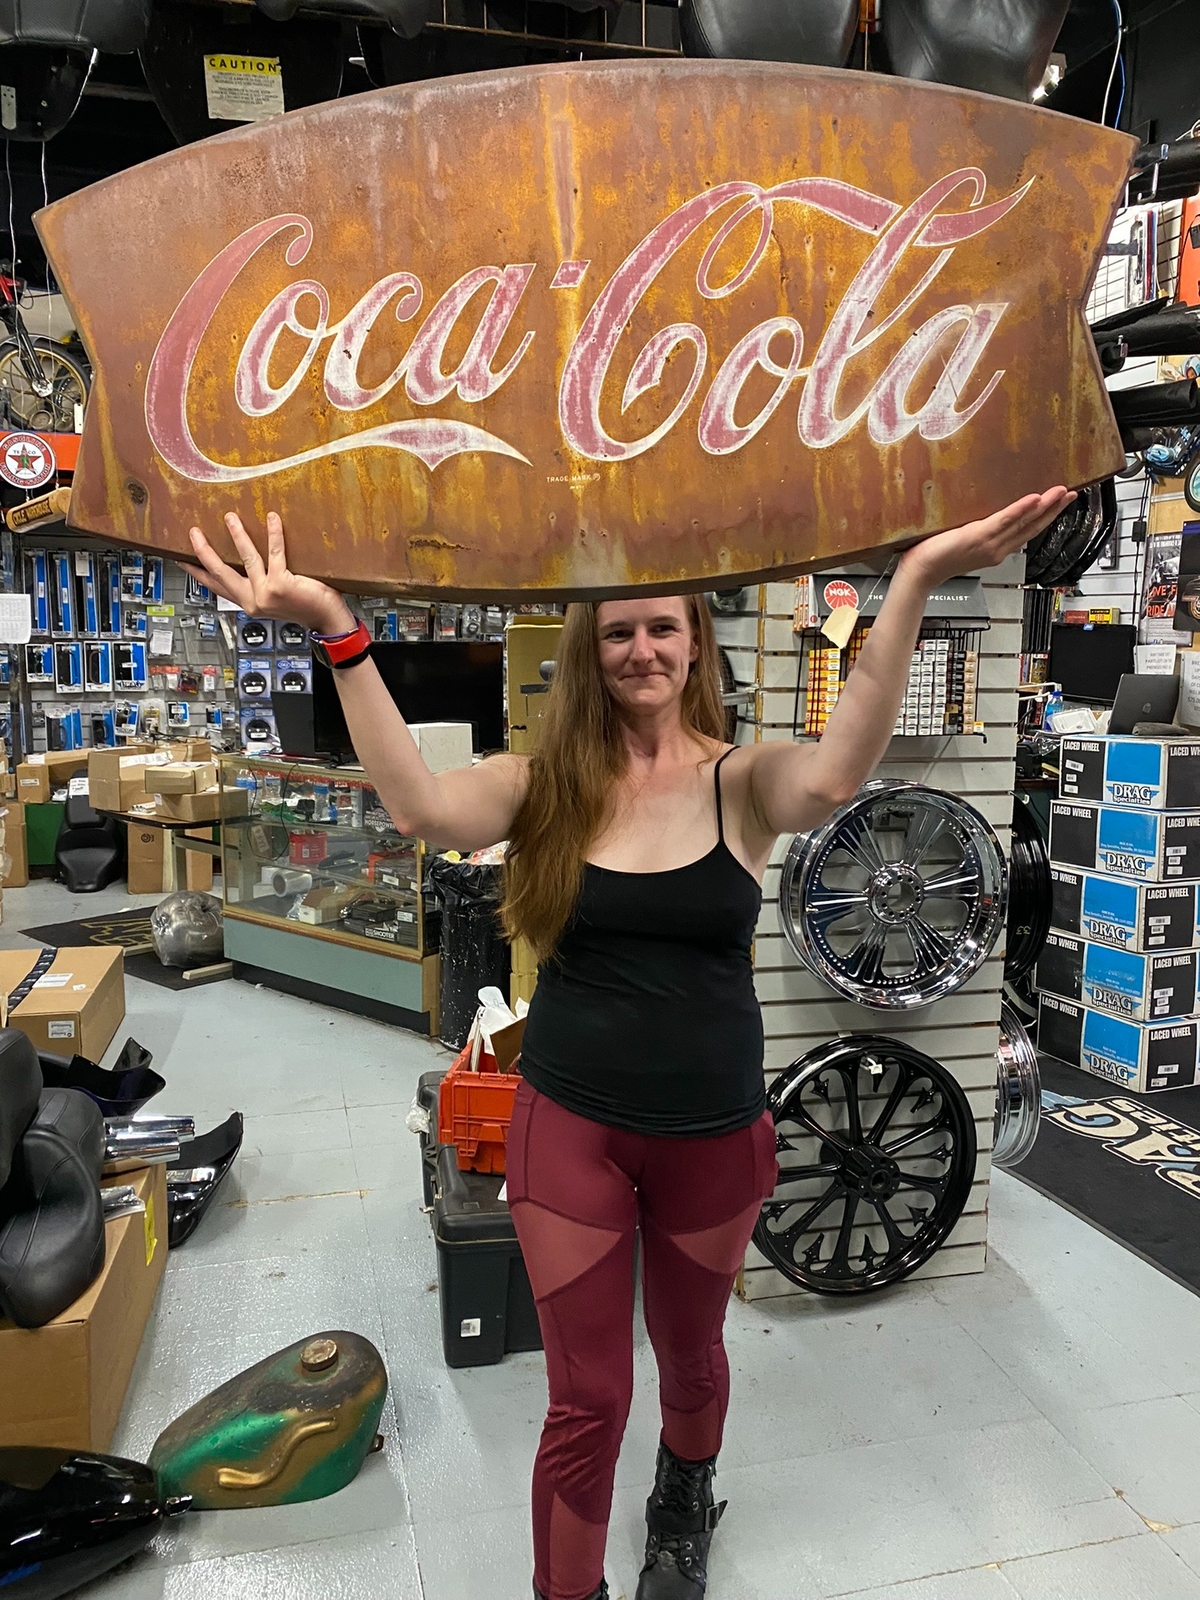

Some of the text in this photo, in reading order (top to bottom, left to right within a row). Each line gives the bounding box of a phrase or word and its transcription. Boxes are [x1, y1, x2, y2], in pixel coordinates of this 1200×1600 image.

[209, 58, 277, 73] CAUTION
[829, 588, 851, 597] NGK
[1146, 604, 1164, 616] RIDE
[1063, 742, 1100, 752] LACED WHEEL
[1170, 747, 1189, 756] LACED
[1113, 784, 1151, 800] DRAG
[1113, 796, 1151, 805] Specialties
[1053, 806, 1092, 818] LACED WHEEL
[1167, 819, 1185, 828] LACED
[1106, 852, 1146, 871] DRAG
[1106, 865, 1146, 876] Specialties
[1059, 872, 1078, 885] WHEEL
[1147, 887, 1189, 899] LACED WHEEL
[1090, 920, 1126, 940] DRAG
[1058, 937, 1078, 951] WHEEL
[1090, 932, 1126, 946] Specialties
[1154, 955, 1191, 968] LACED WHEEL
[1092, 986, 1133, 1011] DRAG
[1041, 996, 1078, 1017] LACED WHEEL
[1092, 1000, 1132, 1015] Specialties
[1150, 1026, 1191, 1041] LACED WHEEL
[1090, 1054, 1128, 1080] DRAG
[1090, 1067, 1128, 1085] Specialties
